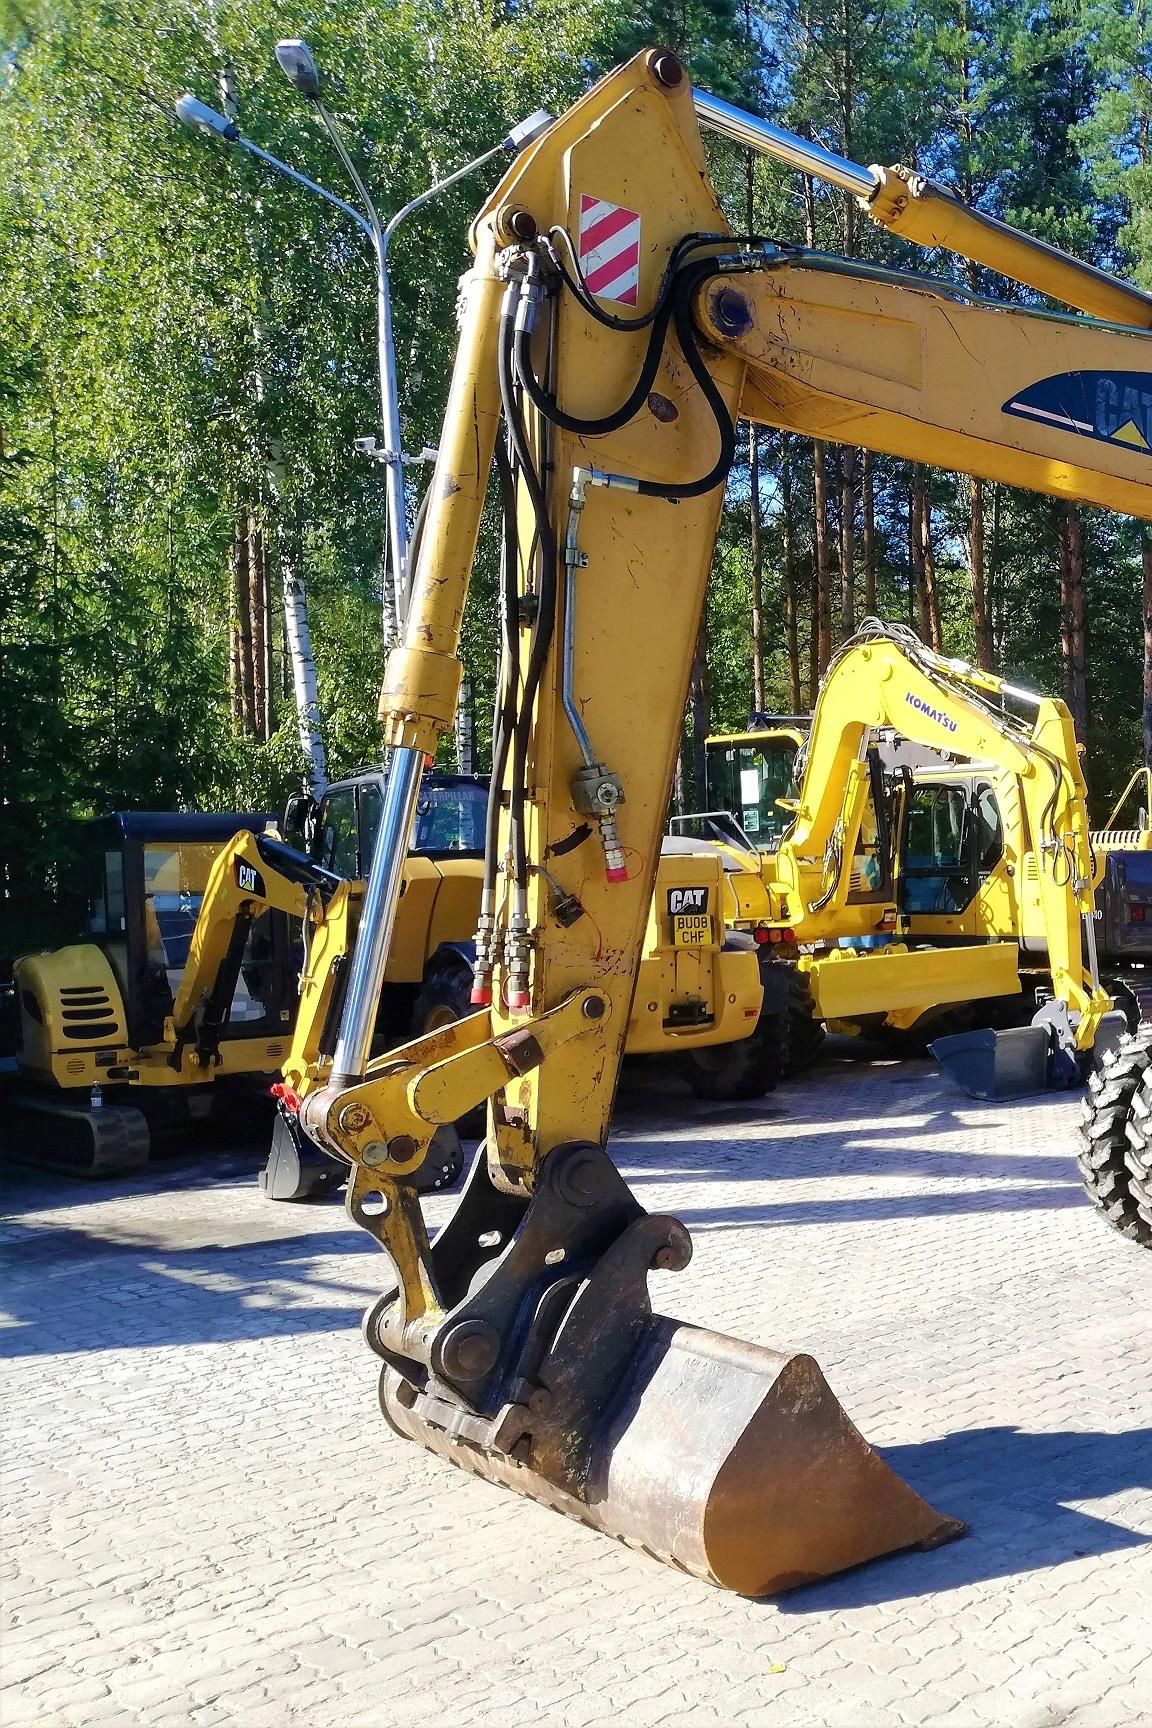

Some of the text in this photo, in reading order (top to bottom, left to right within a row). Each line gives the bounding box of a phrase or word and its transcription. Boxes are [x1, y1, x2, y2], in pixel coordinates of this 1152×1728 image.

[905, 692, 957, 732] KOMATSU
[239, 865, 257, 891] CAT
[670, 889, 705, 914] CAT
[677, 916, 708, 930] BU08
[682, 931, 705, 944] CHF
